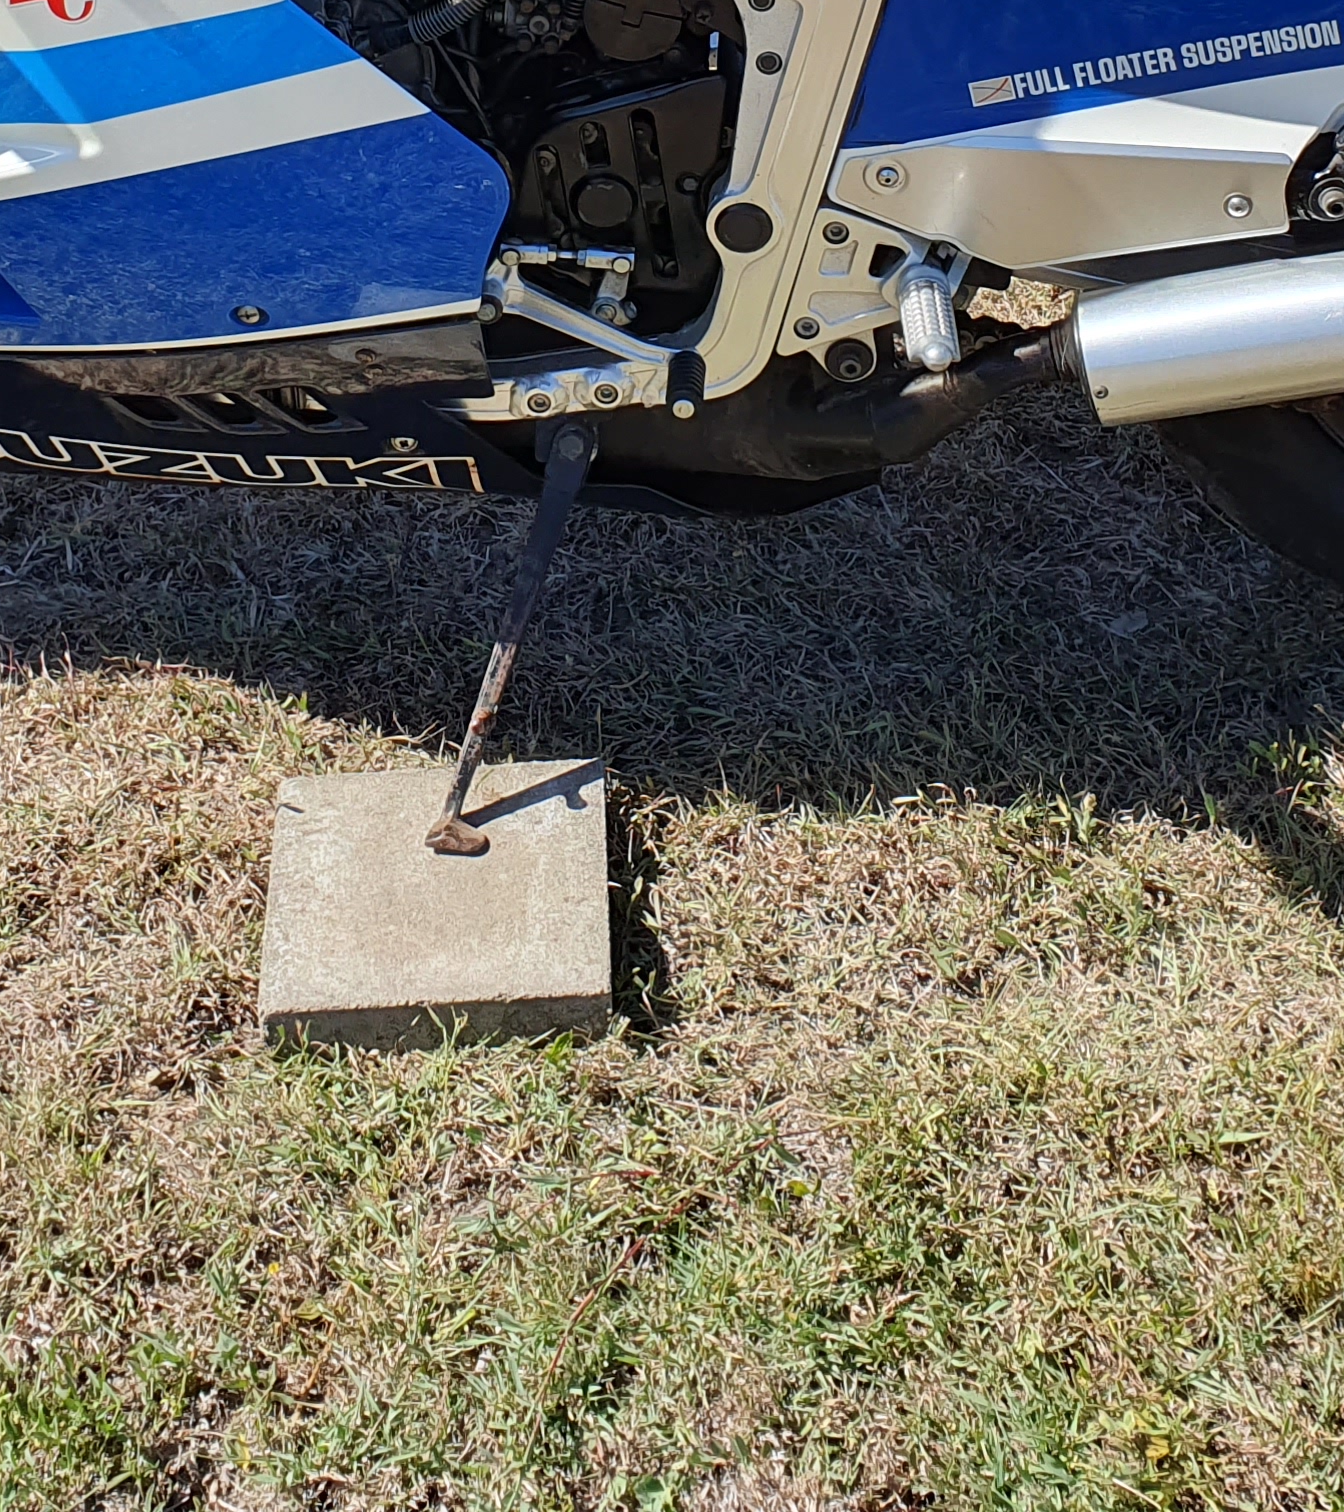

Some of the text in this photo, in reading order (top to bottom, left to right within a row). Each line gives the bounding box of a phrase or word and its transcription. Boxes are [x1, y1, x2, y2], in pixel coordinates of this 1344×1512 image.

[1014, 19, 1342, 98] FULL FLOATER SUSPENSION
